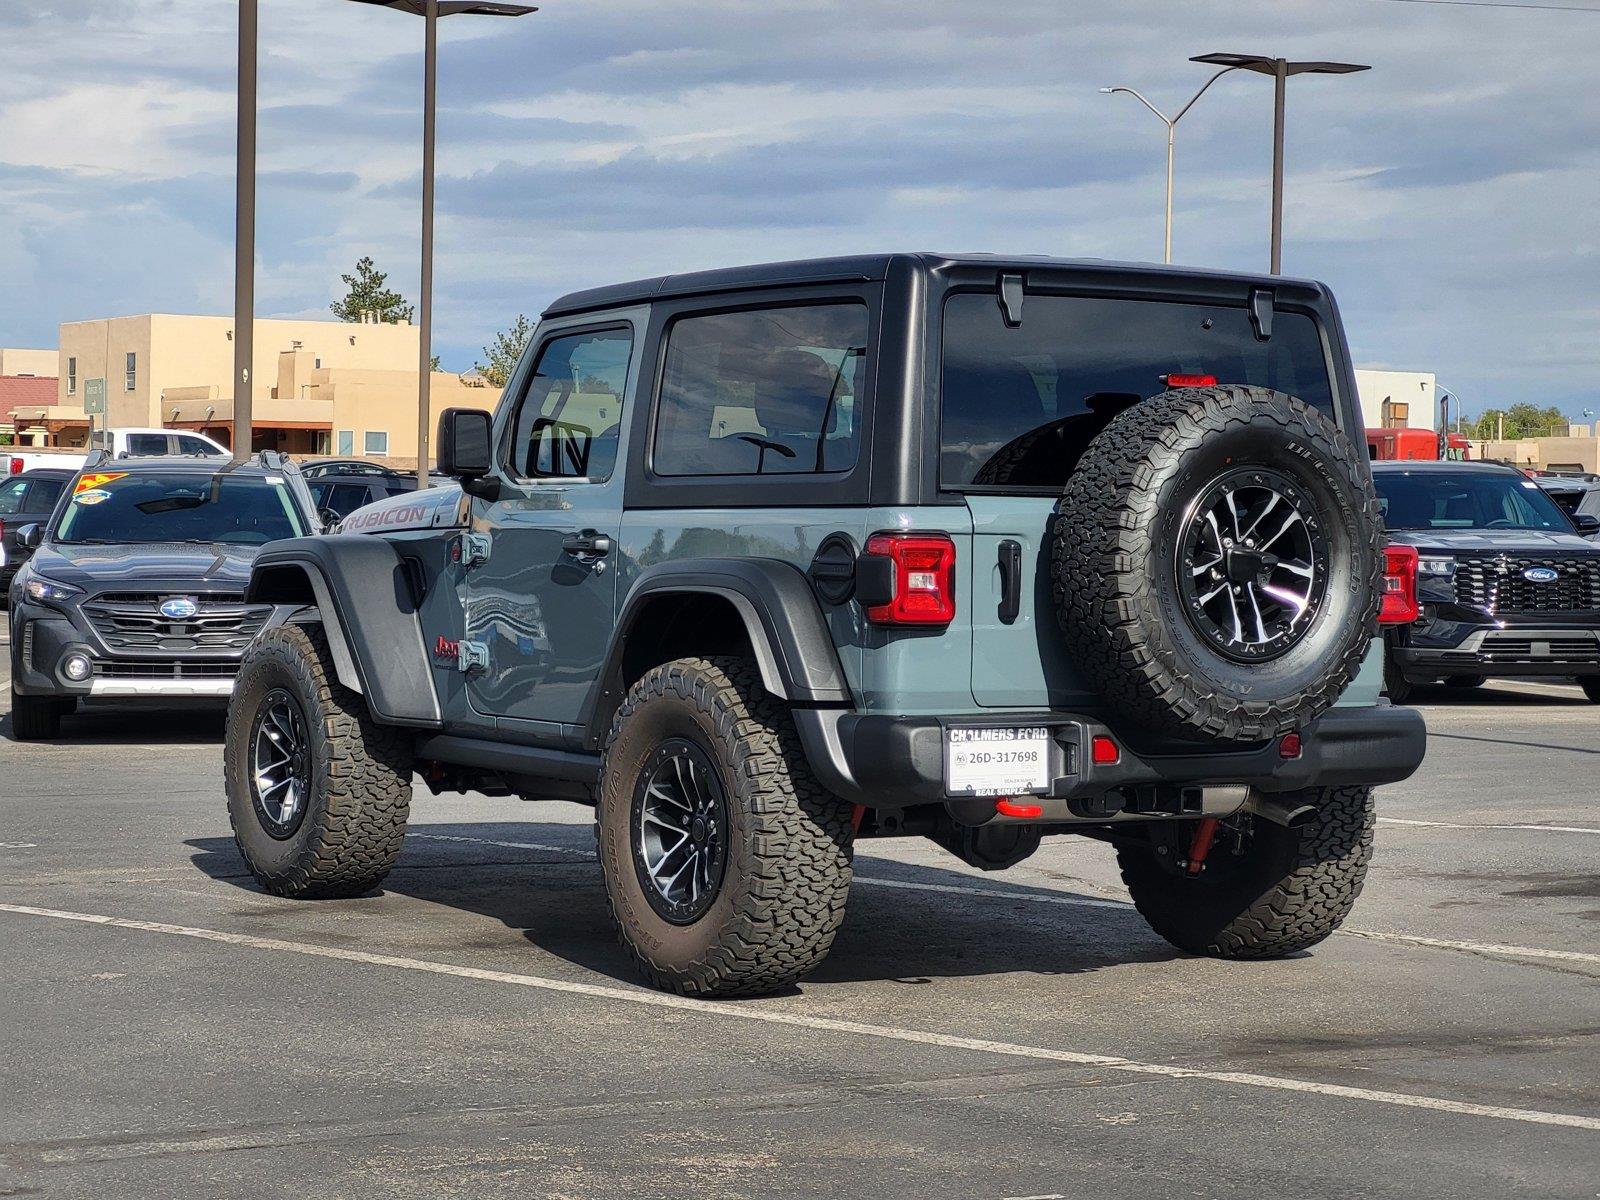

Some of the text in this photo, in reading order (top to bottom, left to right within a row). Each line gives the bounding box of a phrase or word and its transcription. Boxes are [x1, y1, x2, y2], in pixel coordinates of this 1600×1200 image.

[343, 505, 426, 531] RUBICON
[434, 635, 459, 657] Jeep
[969, 751, 1038, 764] 26D-317698
[975, 788, 996, 797] REAL
